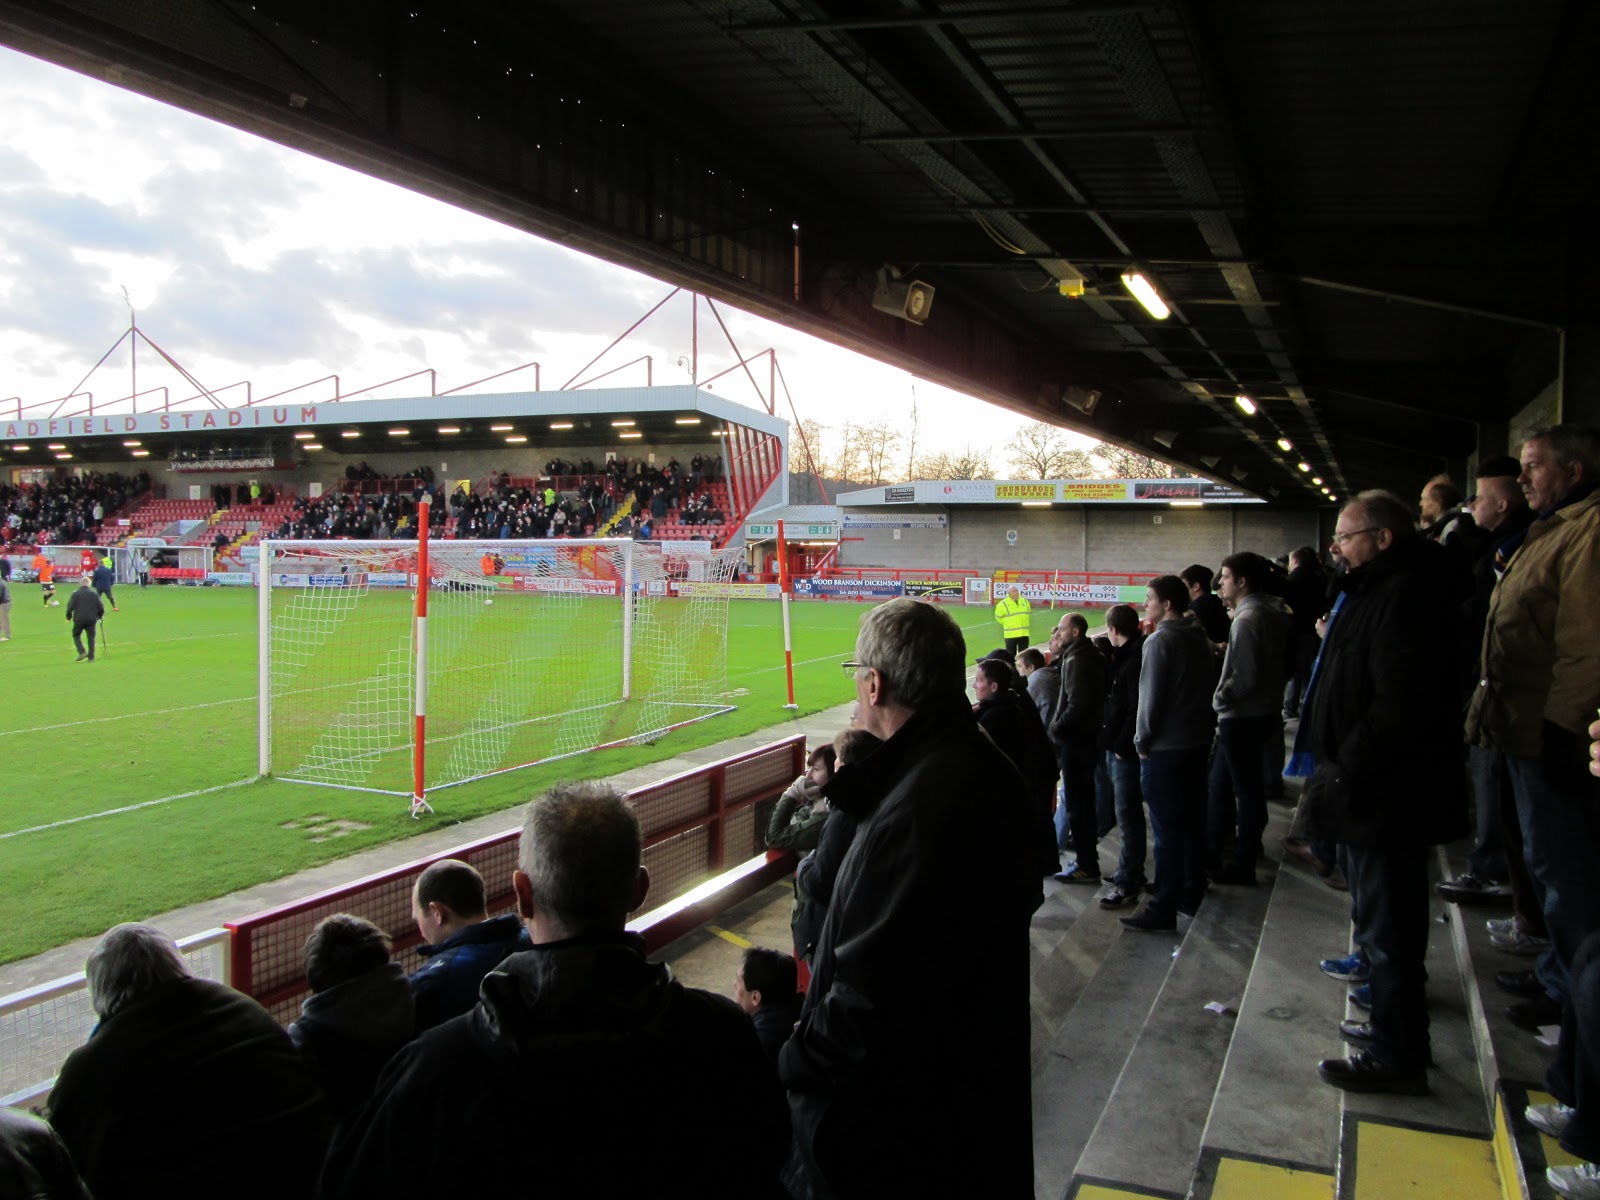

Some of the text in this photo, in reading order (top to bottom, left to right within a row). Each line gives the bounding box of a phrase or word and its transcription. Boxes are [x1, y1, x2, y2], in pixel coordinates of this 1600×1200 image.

[6, 406, 317, 438] ADFIELD STADIUM
[812, 578, 833, 586] WOOD
[864, 579, 901, 587] DICKINSON
[1022, 582, 1090, 593] STUNNING
[996, 590, 1117, 599] GNITE WORKTOPS
